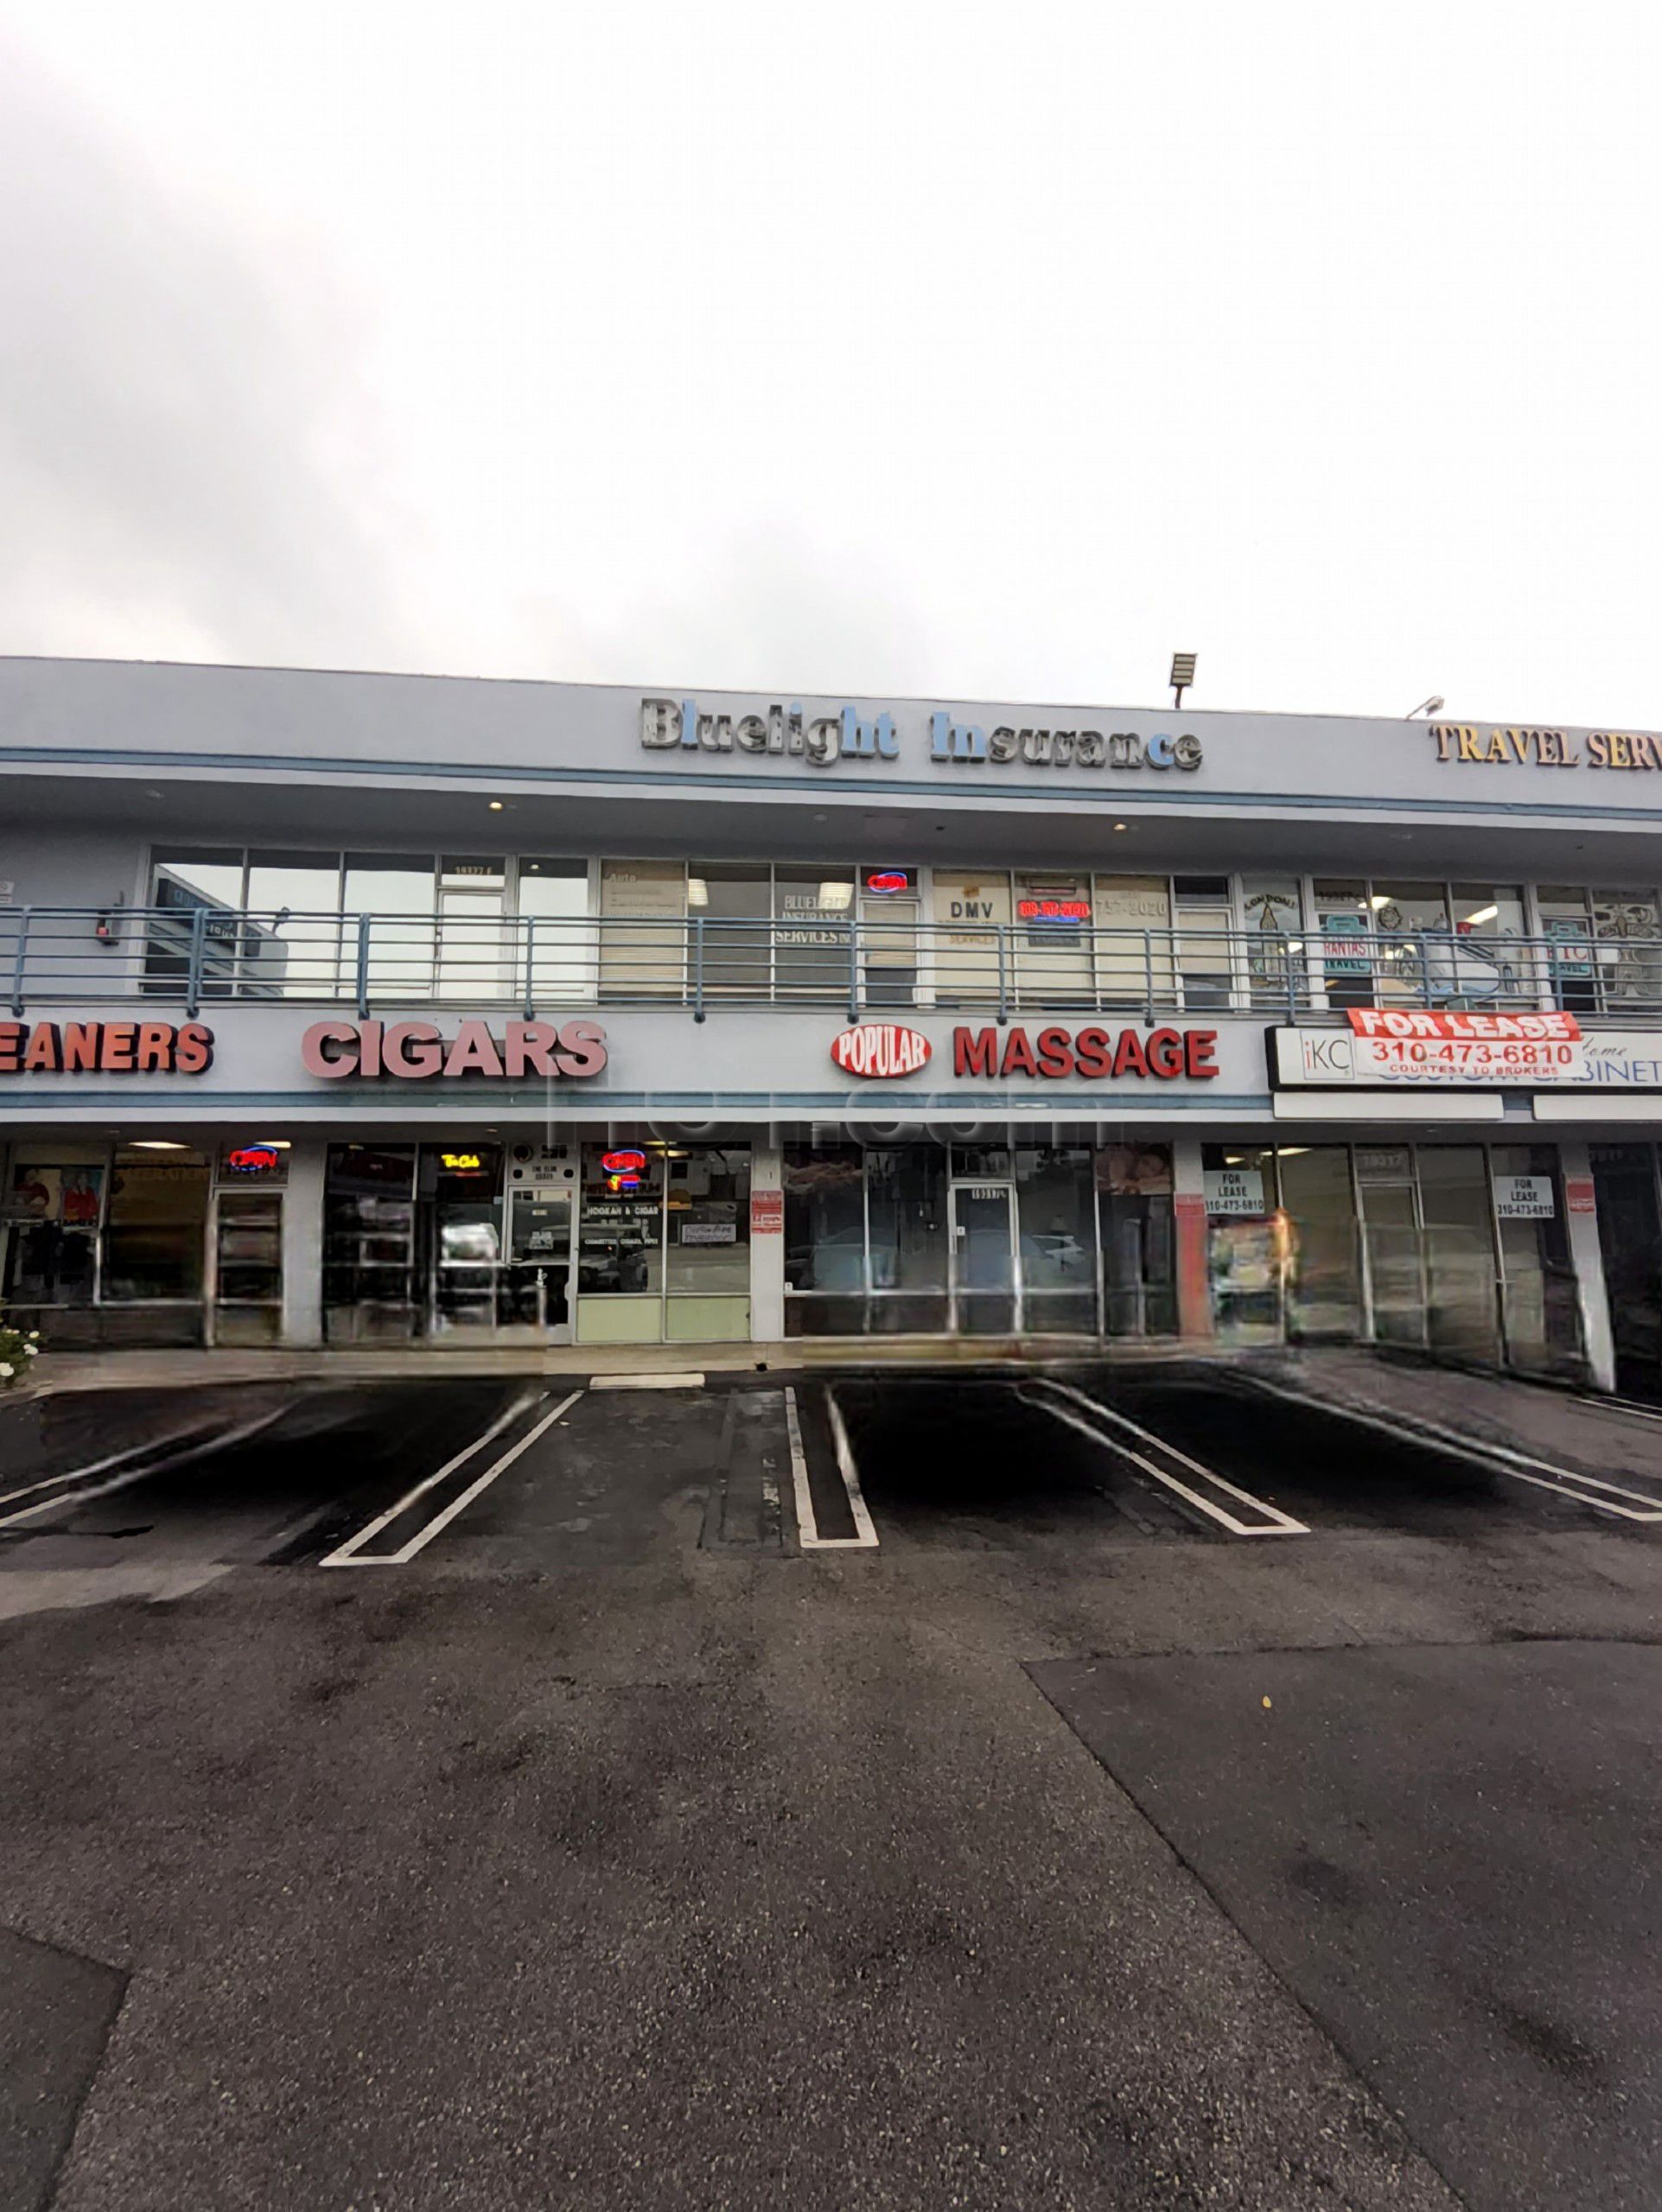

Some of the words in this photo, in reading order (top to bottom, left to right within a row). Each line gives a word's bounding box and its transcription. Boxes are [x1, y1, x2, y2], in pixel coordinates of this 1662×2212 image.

[640, 697, 901, 767] Bluelight
[930, 711, 1203, 770] Insurance
[1429, 723, 1581, 766] TRAVEL
[951, 901, 993, 918] DMV
[775, 931, 837, 944] SERVICES
[1360, 1011, 1436, 1038] FOR
[1445, 1014, 1570, 1039] LEASE
[302, 1020, 608, 1080] CIGARS
[838, 1026, 927, 1075] POPULAR
[954, 1026, 1219, 1078] MASSAGE
[1304, 1039, 1350, 1071] iKC
[1372, 1041, 1573, 1065] 310-473-6810
[1390, 1065, 1466, 1075] COURTESY
[1474, 1065, 1490, 1075] TO
[1496, 1065, 1558, 1076] BROKERS
[230, 1150, 277, 1167] OPEN
[602, 1152, 646, 1169] OPEN
[1223, 1173, 1240, 1184] FOR
[1515, 1179, 1532, 1189] FOR
[1219, 1186, 1247, 1197] LEASE
[1511, 1192, 1538, 1202] LEASE
[587, 1206, 622, 1216] HOOKAH
